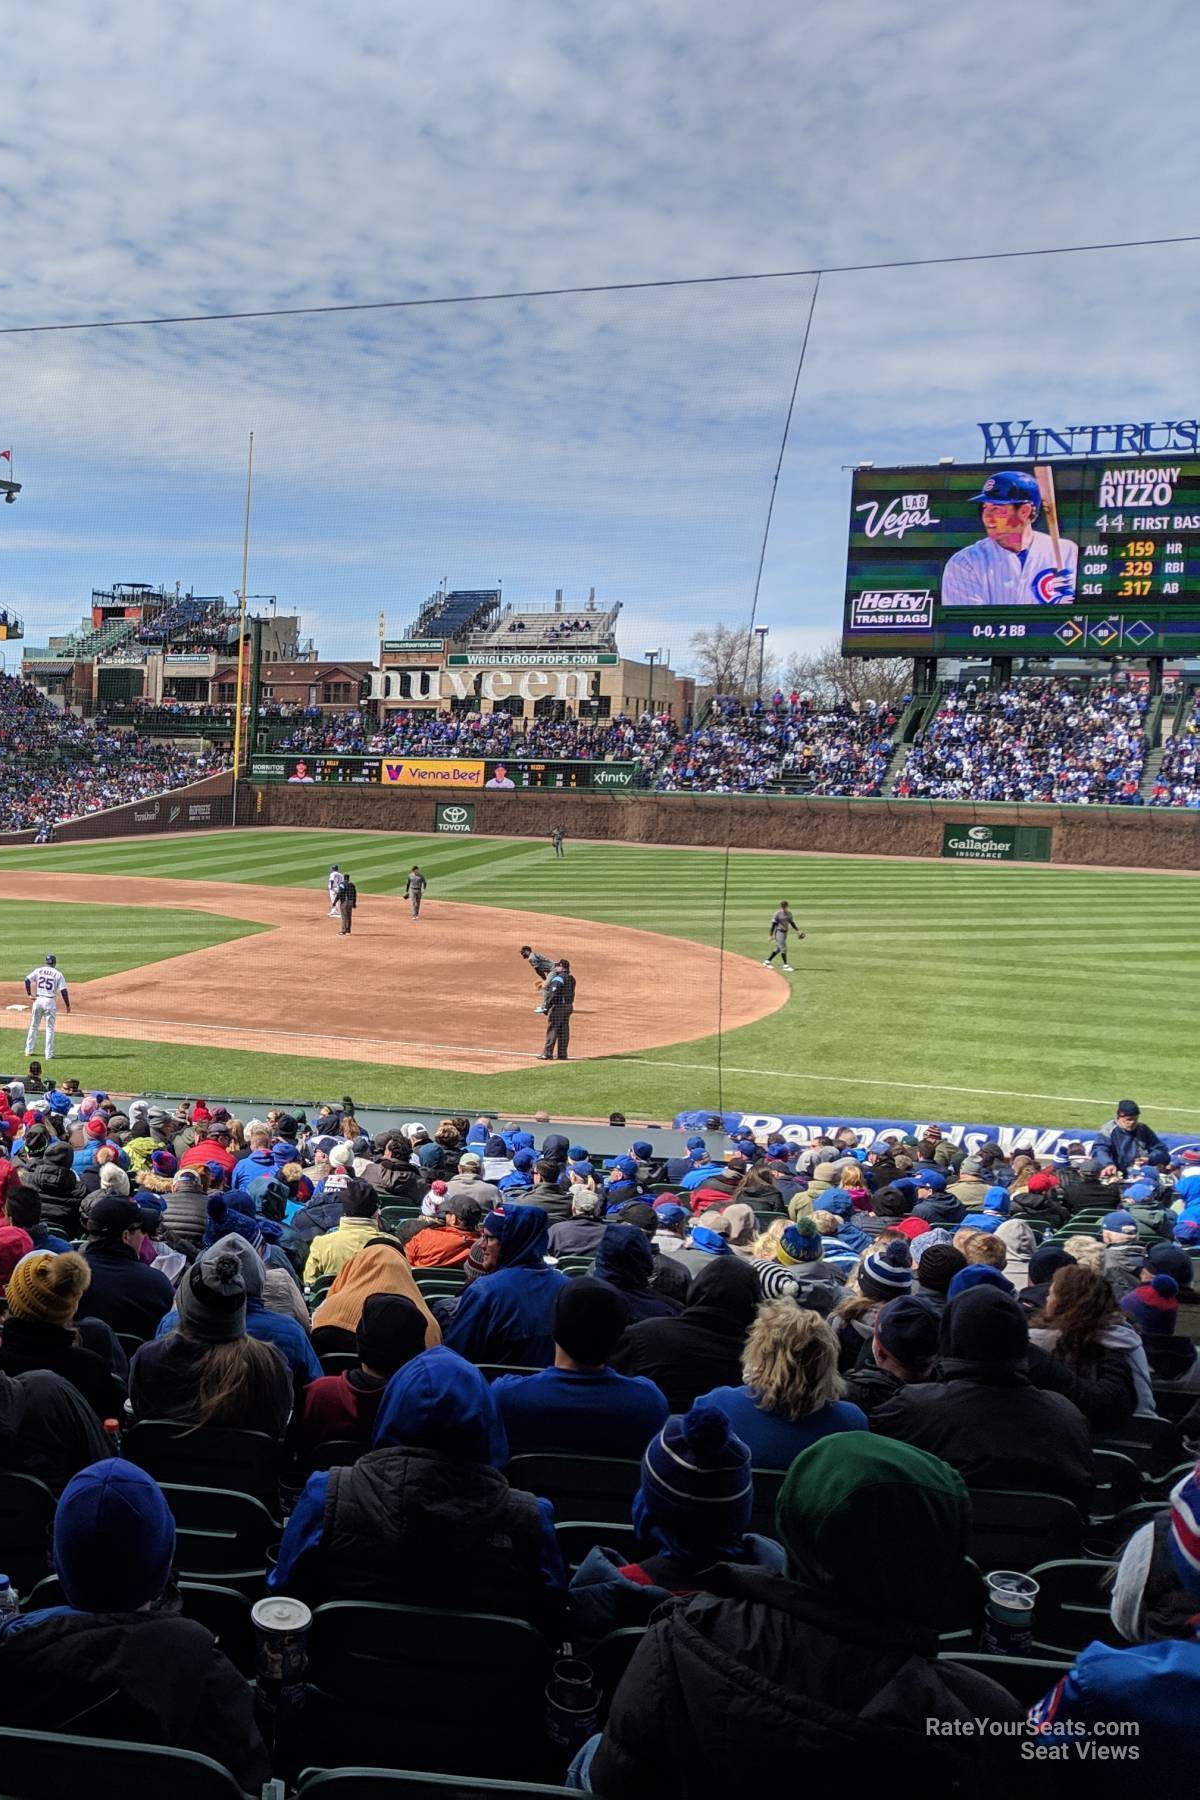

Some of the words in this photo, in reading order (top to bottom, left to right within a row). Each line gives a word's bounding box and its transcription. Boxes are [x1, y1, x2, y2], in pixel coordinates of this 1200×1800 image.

[1101, 467, 1181, 486] ANTHONY
[905, 496, 926, 508] LAS
[1099, 484, 1173, 508] RIZZO
[856, 498, 940, 539] Vegas
[1095, 514, 1125, 532] 44
[1132, 516, 1170, 530] FIRST
[1084, 544, 1108, 556] AVG
[1120, 541, 1155, 557] .159
[1166, 543, 1183, 554] HR
[1084, 563, 1107, 575] OBP
[1118, 561, 1153, 577] .329
[1165, 562, 1184, 573] RBI
[1082, 583, 1103, 595] SLG
[1117, 580, 1152, 596] .317
[1163, 582, 1179, 593] AB
[862, 593, 923, 610] Hefty
[856, 614, 893, 624] TRASH
[896, 614, 928, 623] BAGS
[972, 625, 995, 638] 0-0,
[999, 625, 1006, 637] 2
[1010, 625, 1026, 637] BB
[467, 655, 598, 664] WRIGLEYROOFTOPS.COM
[367, 670, 591, 700] nuveen
[409, 768, 450, 780] Vienna
[453, 769, 481, 783] Beef
[593, 771, 632, 785] xfinity
[438, 823, 471, 831] TOYOTA
[948, 838, 1011, 852] Gallagher
[956, 851, 1002, 859] INSURANCE
[38, 976, 54, 990] 25
